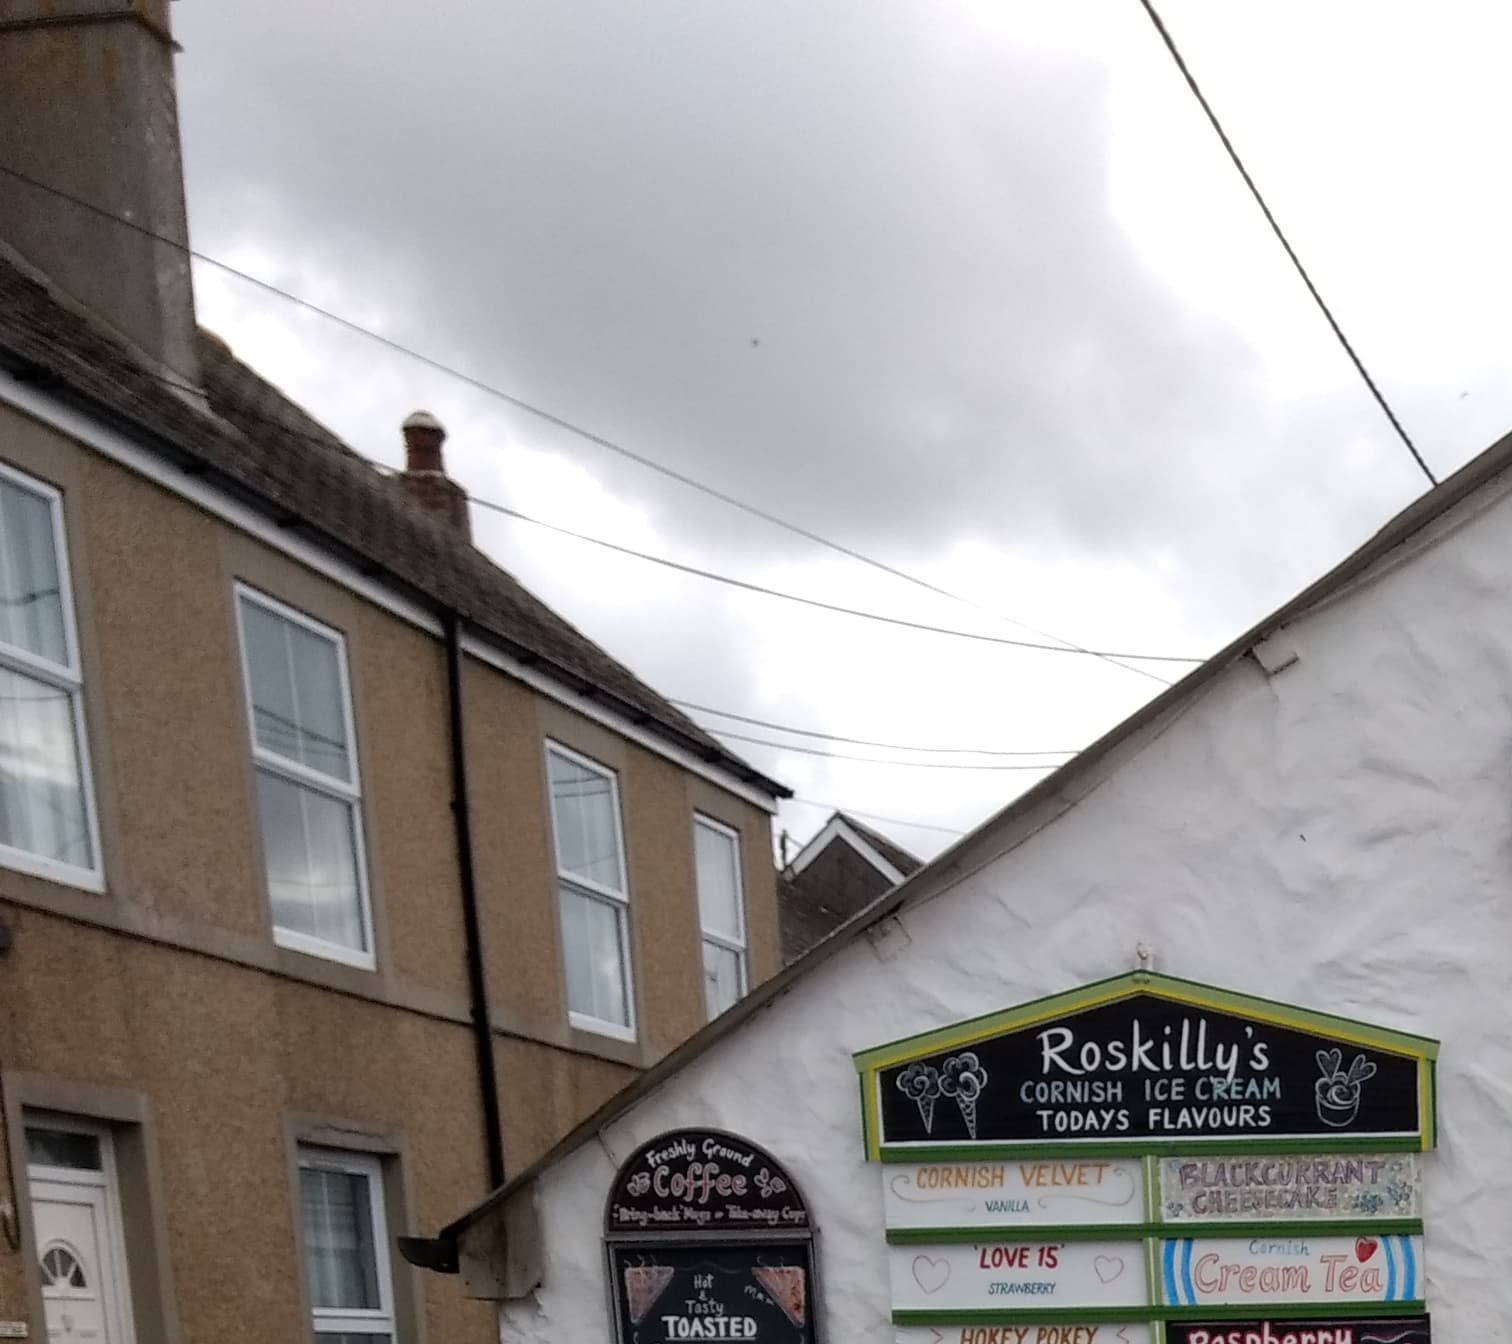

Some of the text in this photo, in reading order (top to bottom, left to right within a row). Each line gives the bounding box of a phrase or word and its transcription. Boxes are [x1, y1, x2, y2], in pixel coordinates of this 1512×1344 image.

[1036, 1018, 1271, 1086] Roskilly's
[1020, 1077, 1281, 1104] CORNISH ICE CREAM
[1036, 1105, 1272, 1133] TODAYS FLAVOURS
[645, 1138, 755, 1168] Freshly Ground
[653, 1162, 748, 1203] Coffee
[916, 1163, 1113, 1189] CORNISH VELVET
[1178, 1160, 1386, 1191] BLACKCURRANT
[985, 1200, 1030, 1212] VANILLA
[1192, 1186, 1339, 1215] CHEESECAKE
[1249, 1239, 1310, 1257] Cornish
[693, 1273, 714, 1289] Hot
[1194, 1253, 1383, 1294] Cream Tea
[988, 1282, 1056, 1295] STRAWBERRY
[685, 1299, 724, 1317] Tasty
[661, 1315, 757, 1338] TOASTED
